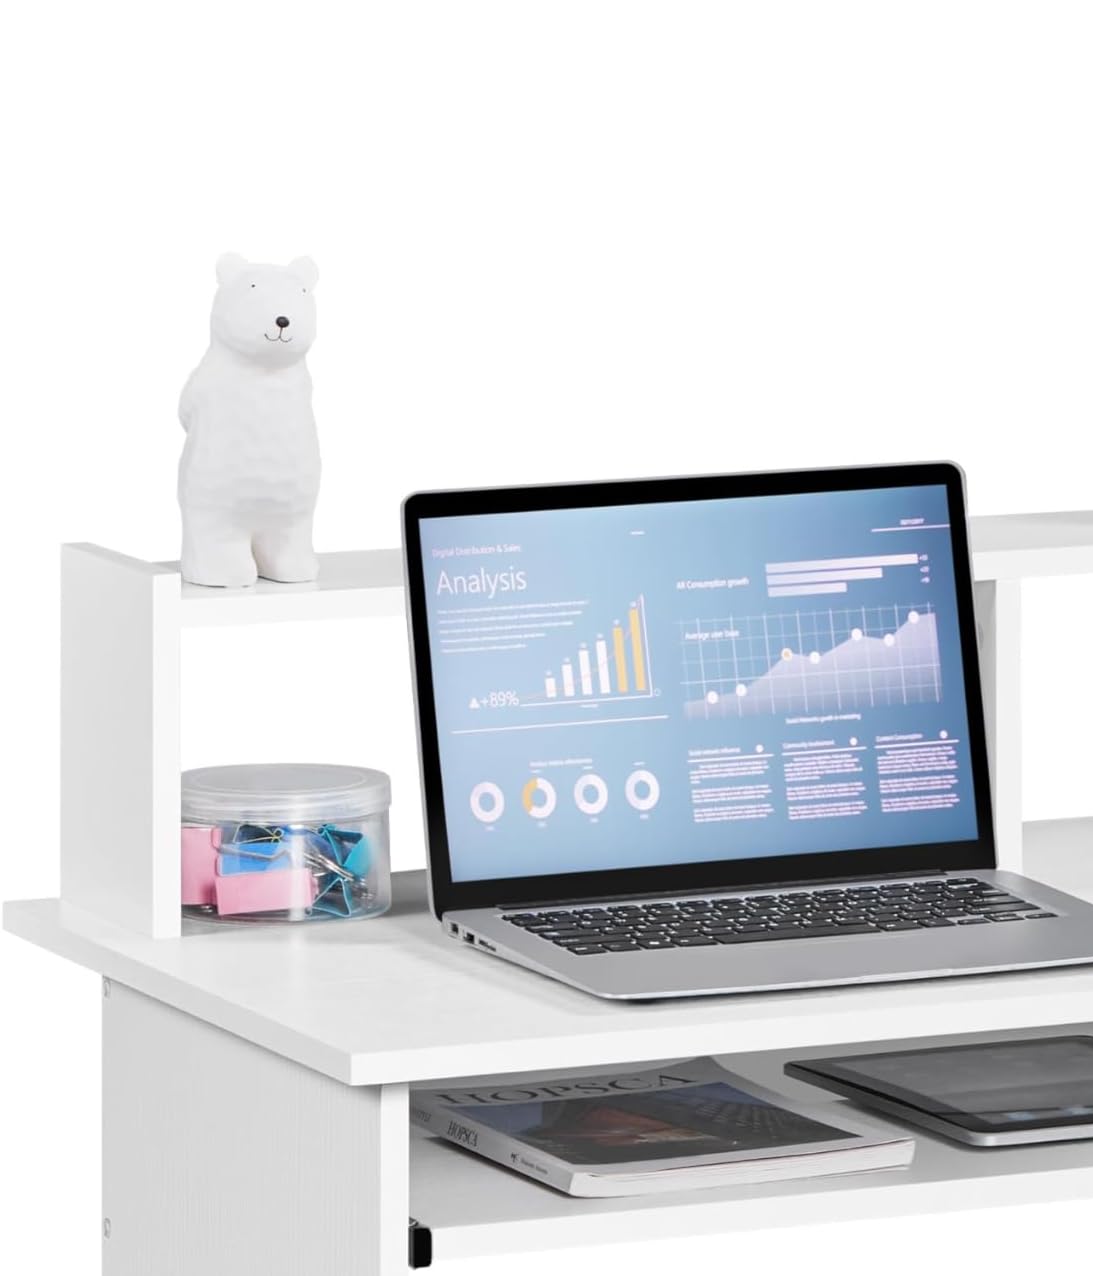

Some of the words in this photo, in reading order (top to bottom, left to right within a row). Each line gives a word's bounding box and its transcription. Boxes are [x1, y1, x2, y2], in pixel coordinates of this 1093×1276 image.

[436, 566, 527, 600] Analysis
[436, 1074, 696, 1104] HOPSCA
[447, 1120, 478, 1148] HOPSCA
